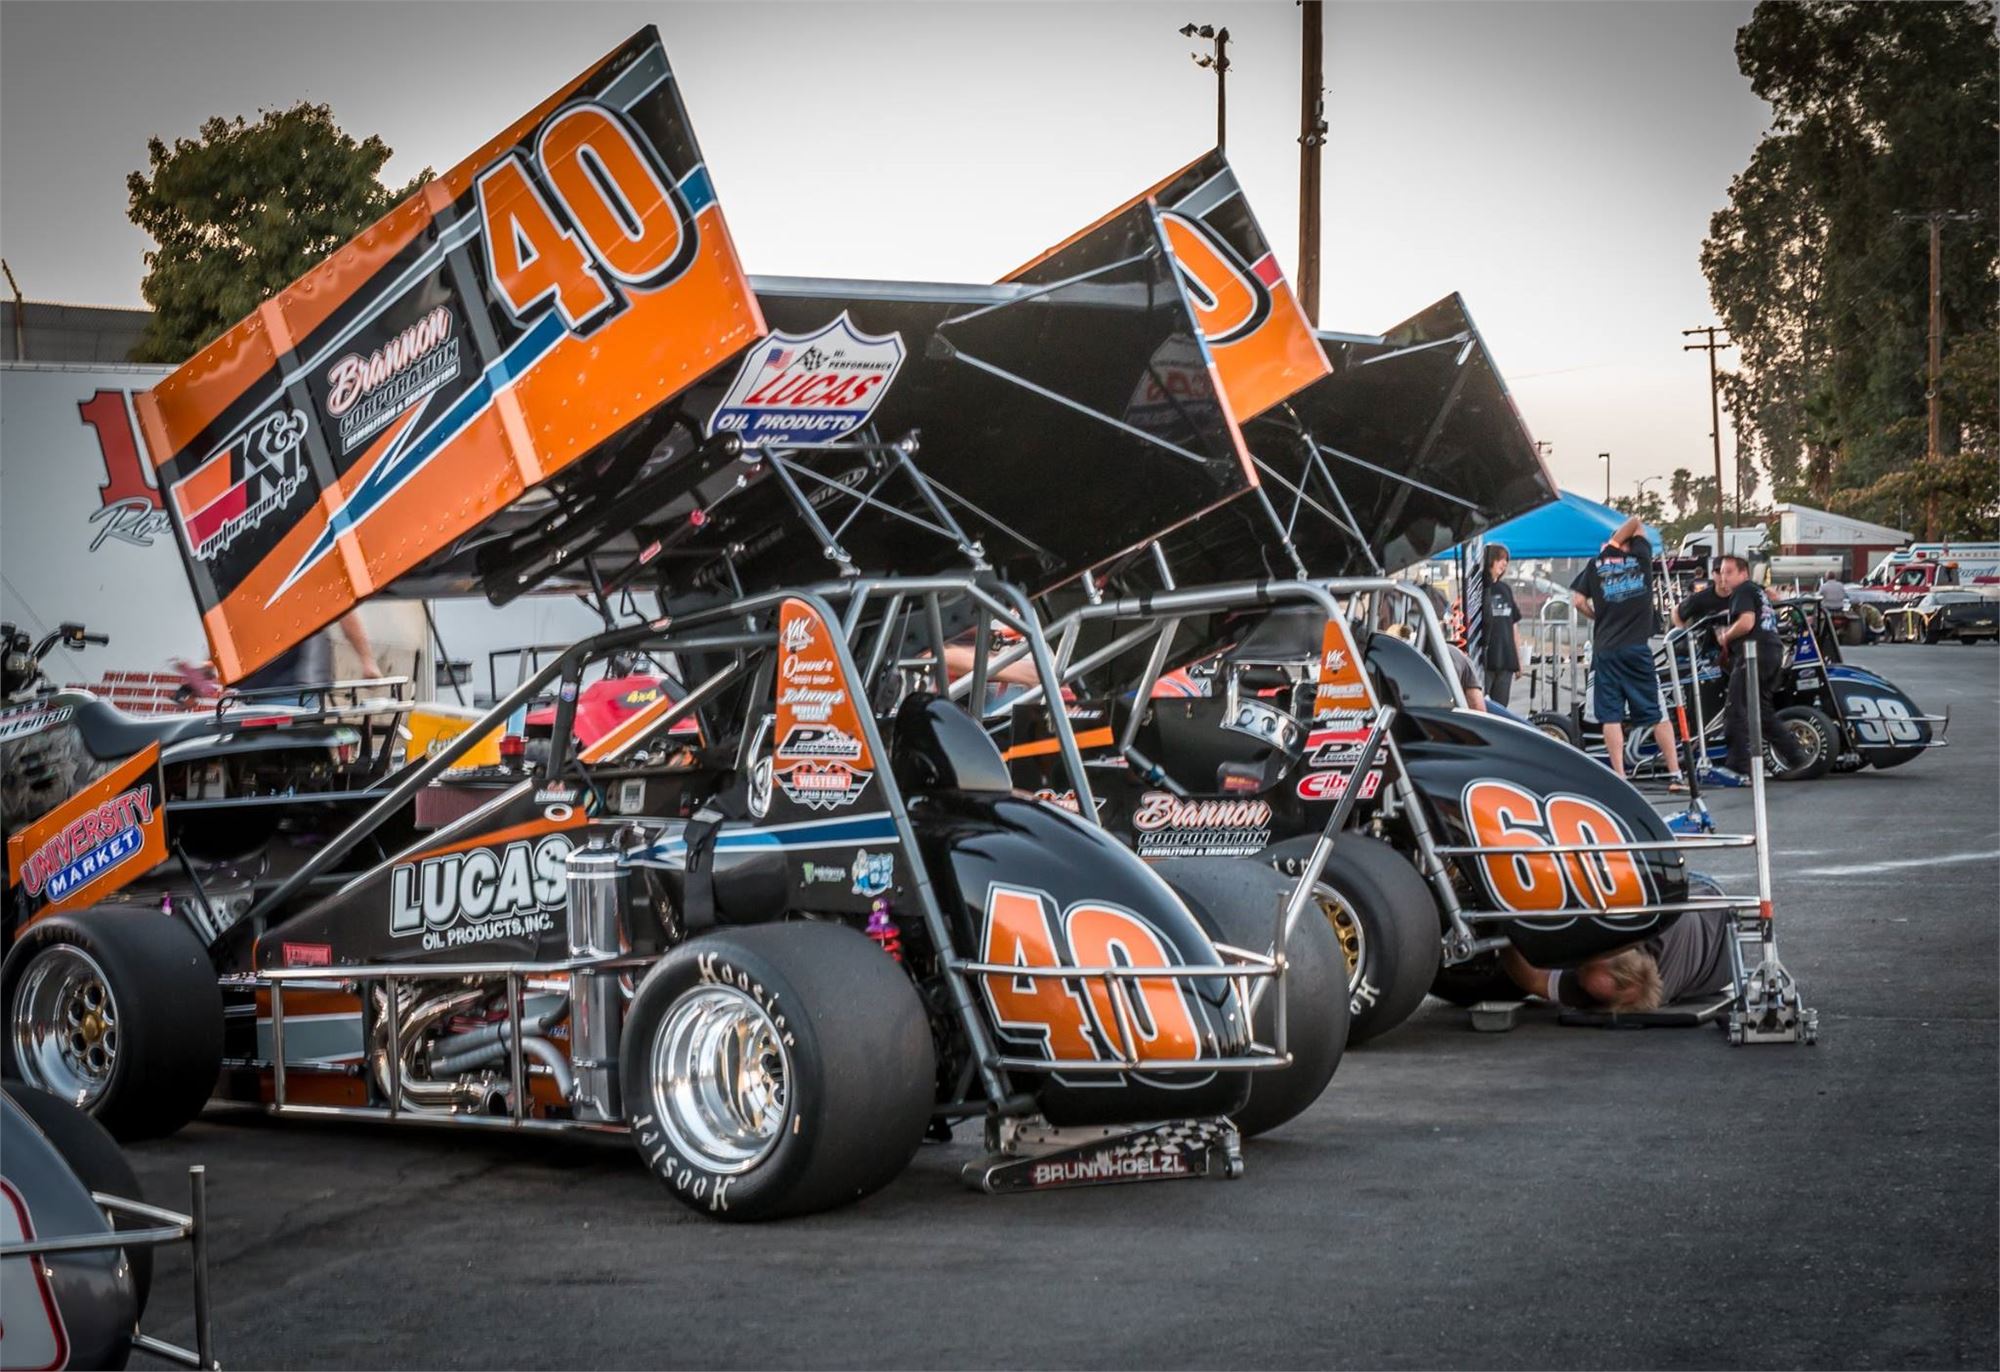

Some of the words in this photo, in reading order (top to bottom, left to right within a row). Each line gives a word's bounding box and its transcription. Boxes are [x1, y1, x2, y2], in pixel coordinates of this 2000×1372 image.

[474, 98, 699, 340] 40
[327, 305, 453, 418] Brannon
[339, 338, 459, 436] CORPORATION
[742, 372, 884, 406] LUCAS
[828, 360, 893, 370] PERFORMANCE
[229, 408, 309, 507] K&N
[717, 414, 750, 431] OIL
[753, 414, 856, 431] PRODUCTS
[198, 478, 297, 562] motorsports
[1134, 789, 1272, 832] Brannon
[1299, 772, 1379, 797] Eibh
[20, 784, 153, 896] UNIVERSITY
[50, 829, 135, 897] MARKET
[1139, 830, 1271, 847] CORPORATION
[1141, 847, 1195, 857] DEMOLITION
[1461, 778, 1656, 922] 60
[390, 833, 576, 938] LUCAS
[422, 933, 446, 950] OIL
[979, 881, 1210, 1080] 40
[697, 951, 796, 1048] Hoosier
